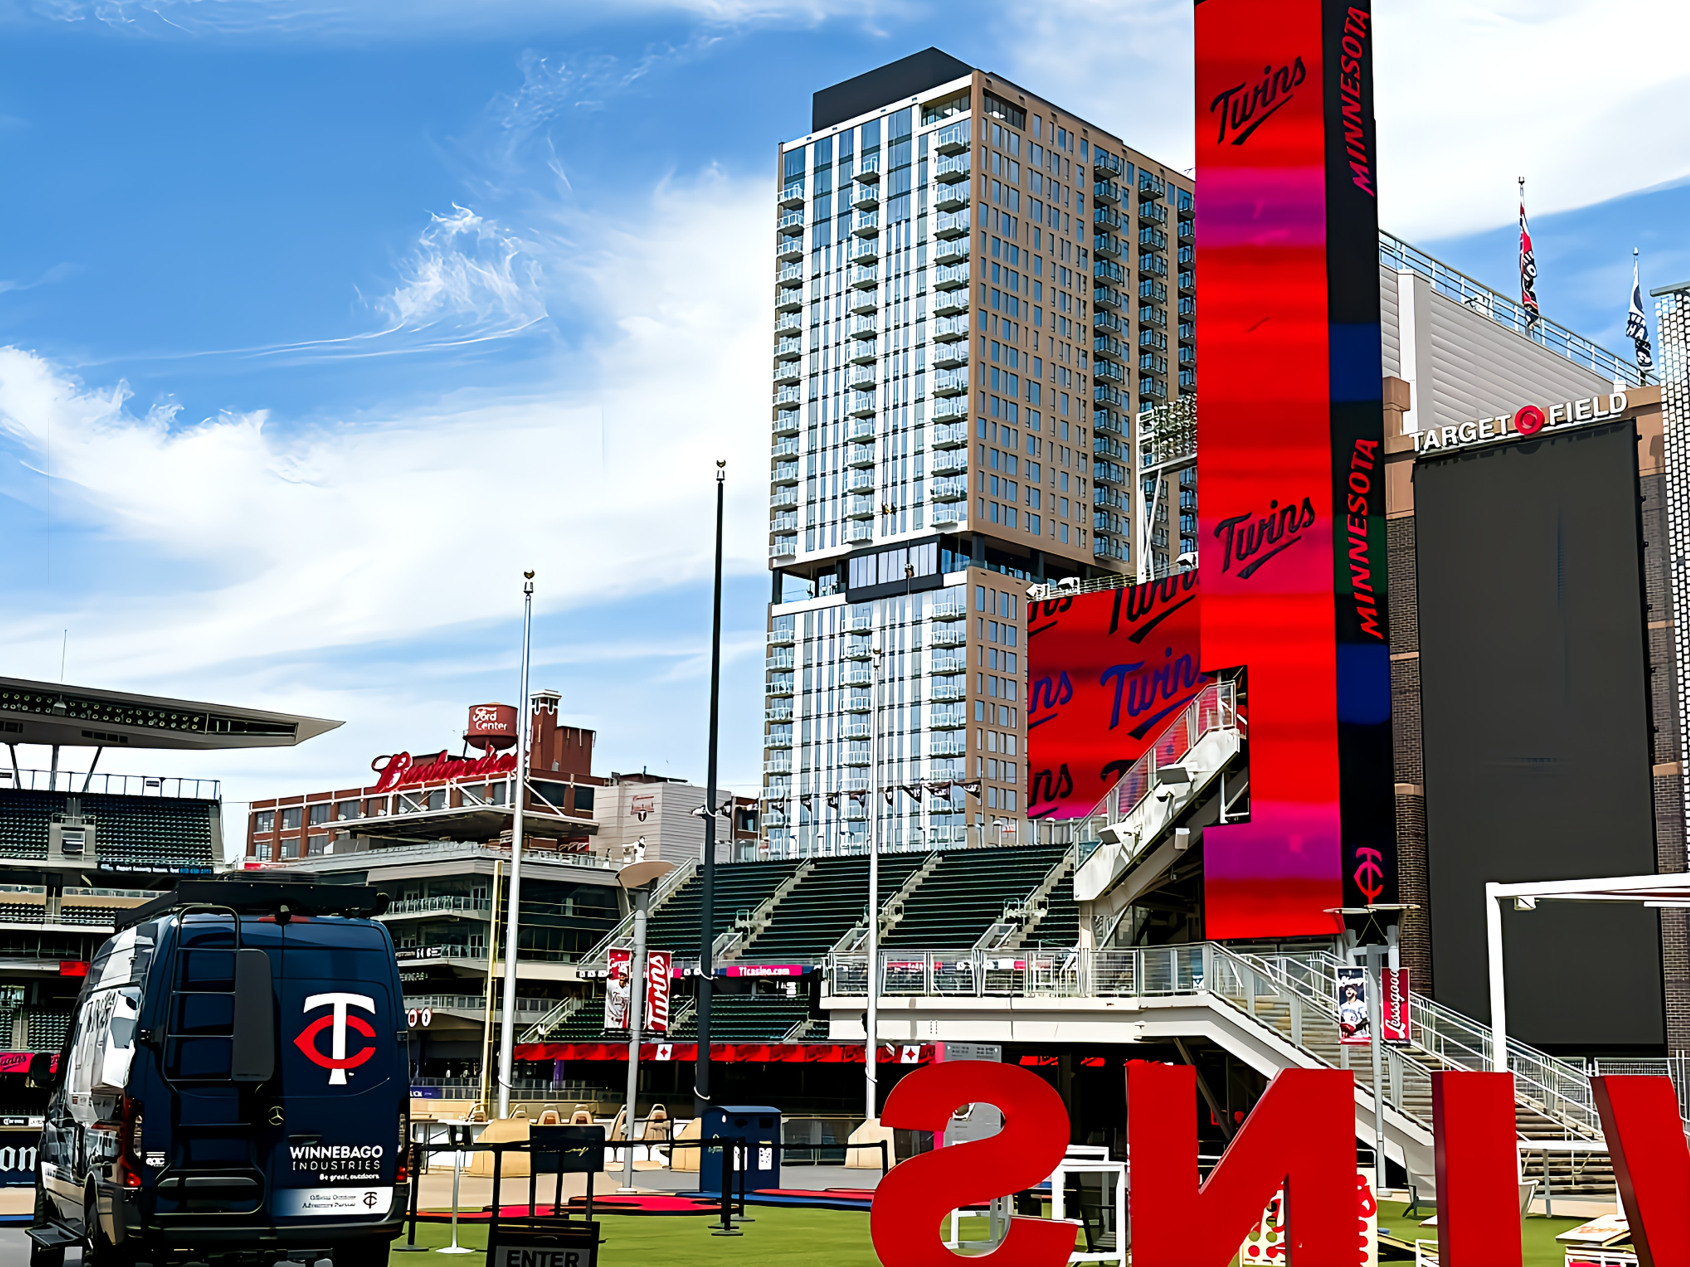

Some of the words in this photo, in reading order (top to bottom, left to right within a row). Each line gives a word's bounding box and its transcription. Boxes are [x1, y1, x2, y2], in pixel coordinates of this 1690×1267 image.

[1210, 55, 1307, 146] Twins
[1340, 6, 1375, 197] MINNESOTA
[1408, 413, 1512, 453] TARGET
[1549, 391, 1629, 426] FIELD
[1214, 496, 1315, 580] Twins
[1347, 438, 1383, 640] MINNESOTA
[472, 706, 498, 722] Ford
[475, 720, 508, 731] Center
[289, 1145, 384, 1159] WINNEBAGO
[292, 1160, 381, 1171] INDUSTRIES
[319, 1173, 329, 1181] Be
[506, 1249, 580, 1267] ENTER
